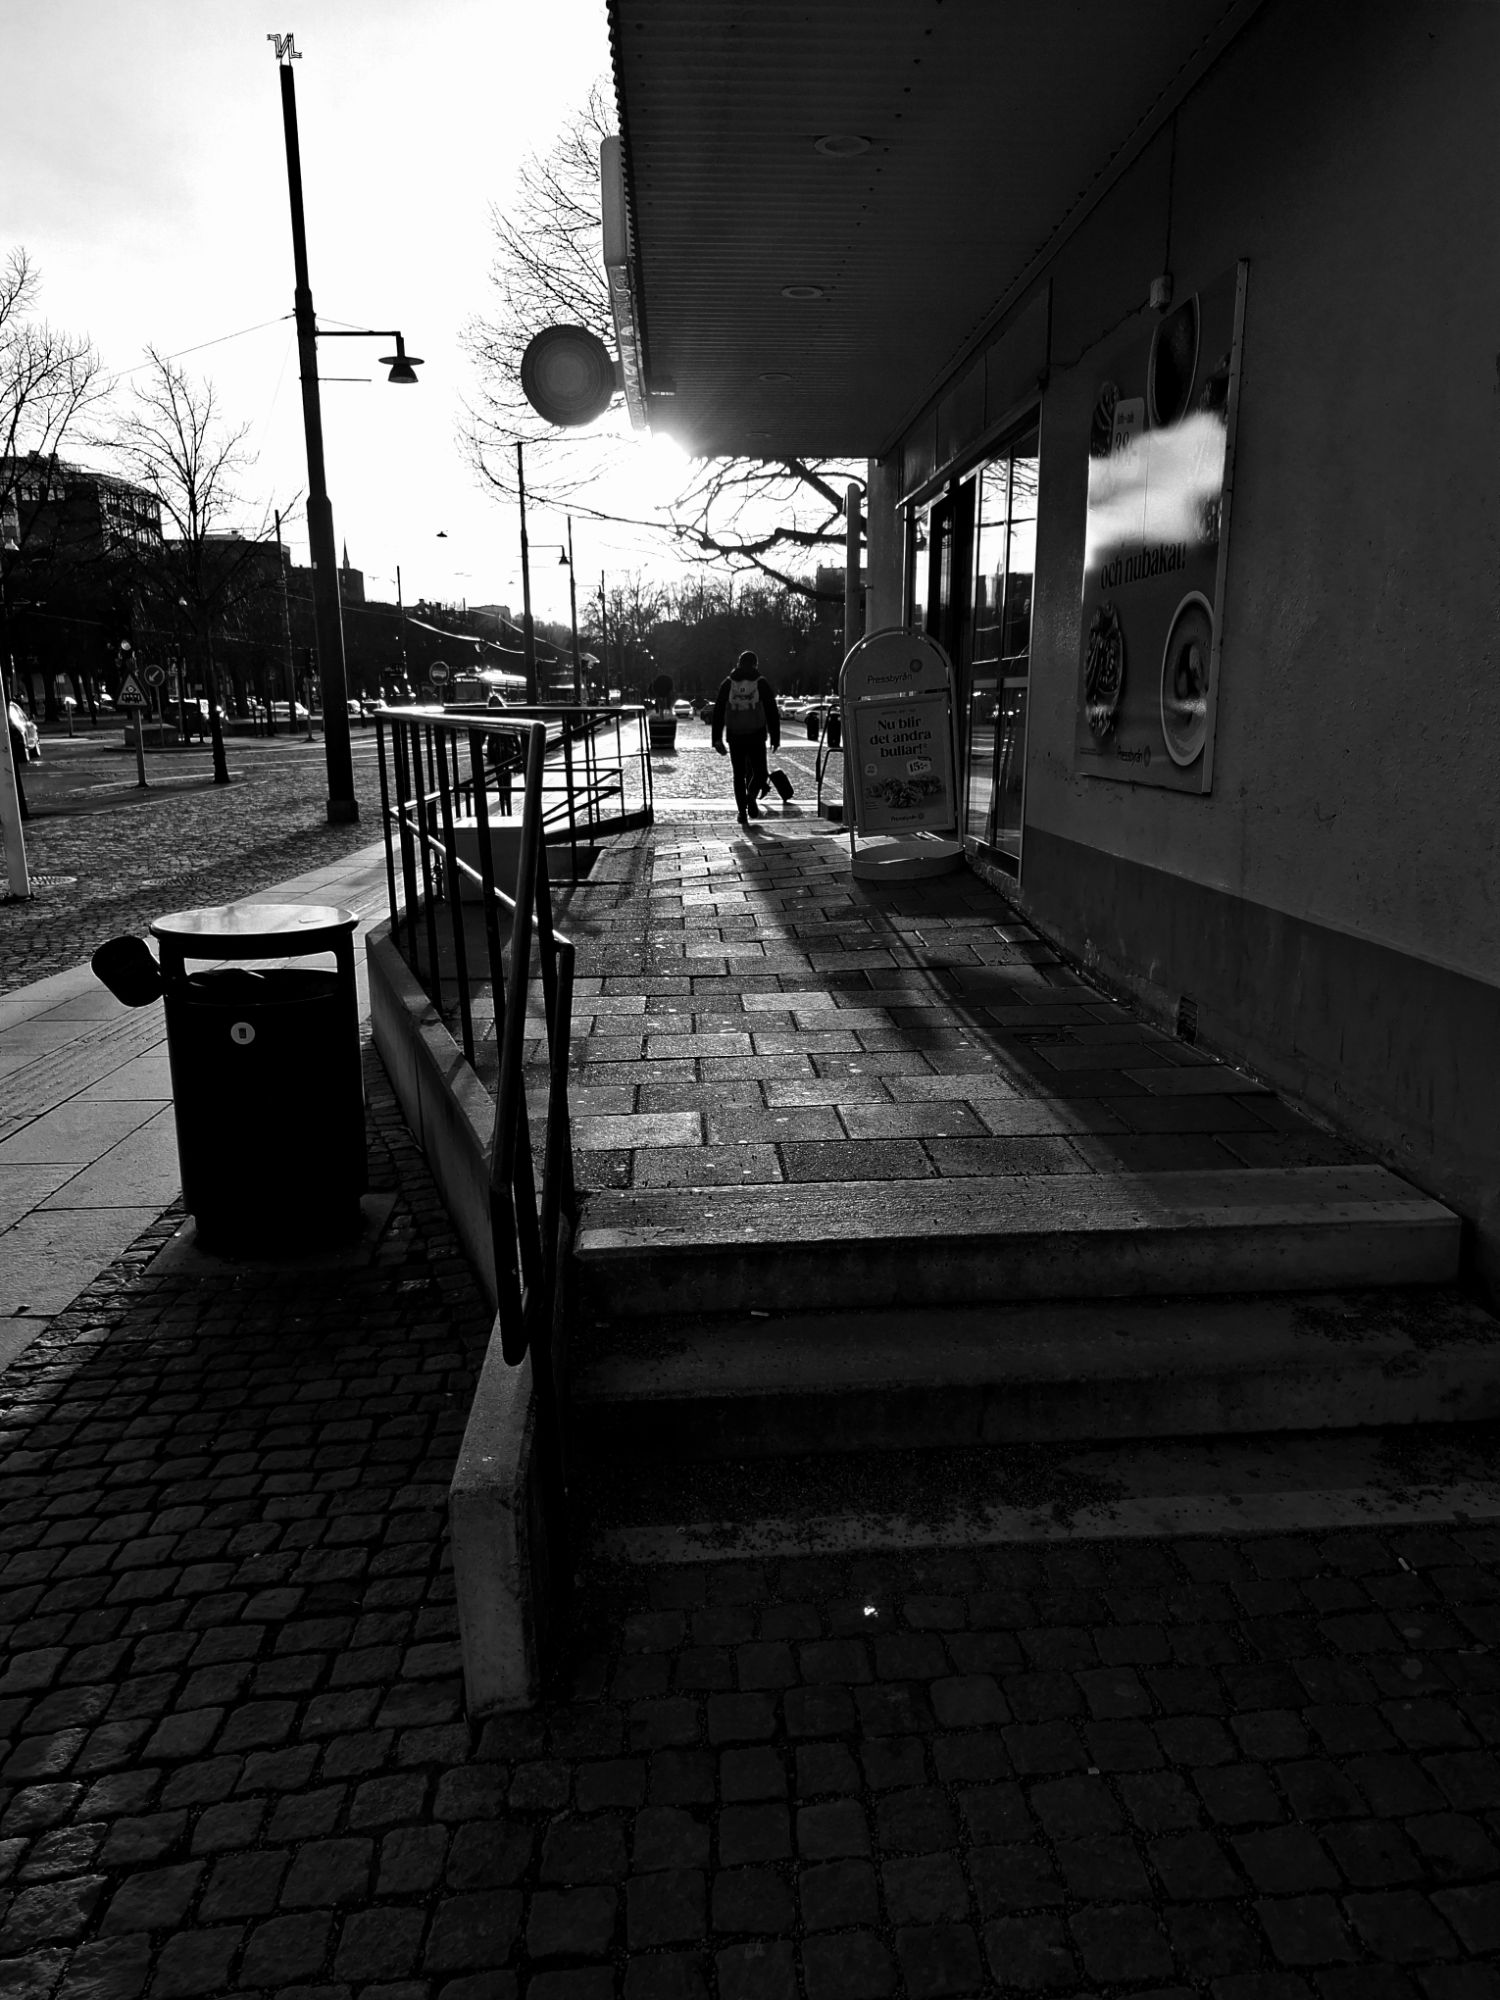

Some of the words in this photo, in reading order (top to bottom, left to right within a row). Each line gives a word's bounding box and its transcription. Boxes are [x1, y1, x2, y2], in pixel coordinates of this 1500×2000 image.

[1101, 555, 1122, 590] och
[878, 719, 896, 731] Nu
[898, 716, 922, 729] blir
[870, 734, 890, 745] det
[892, 730, 932, 743] andra
